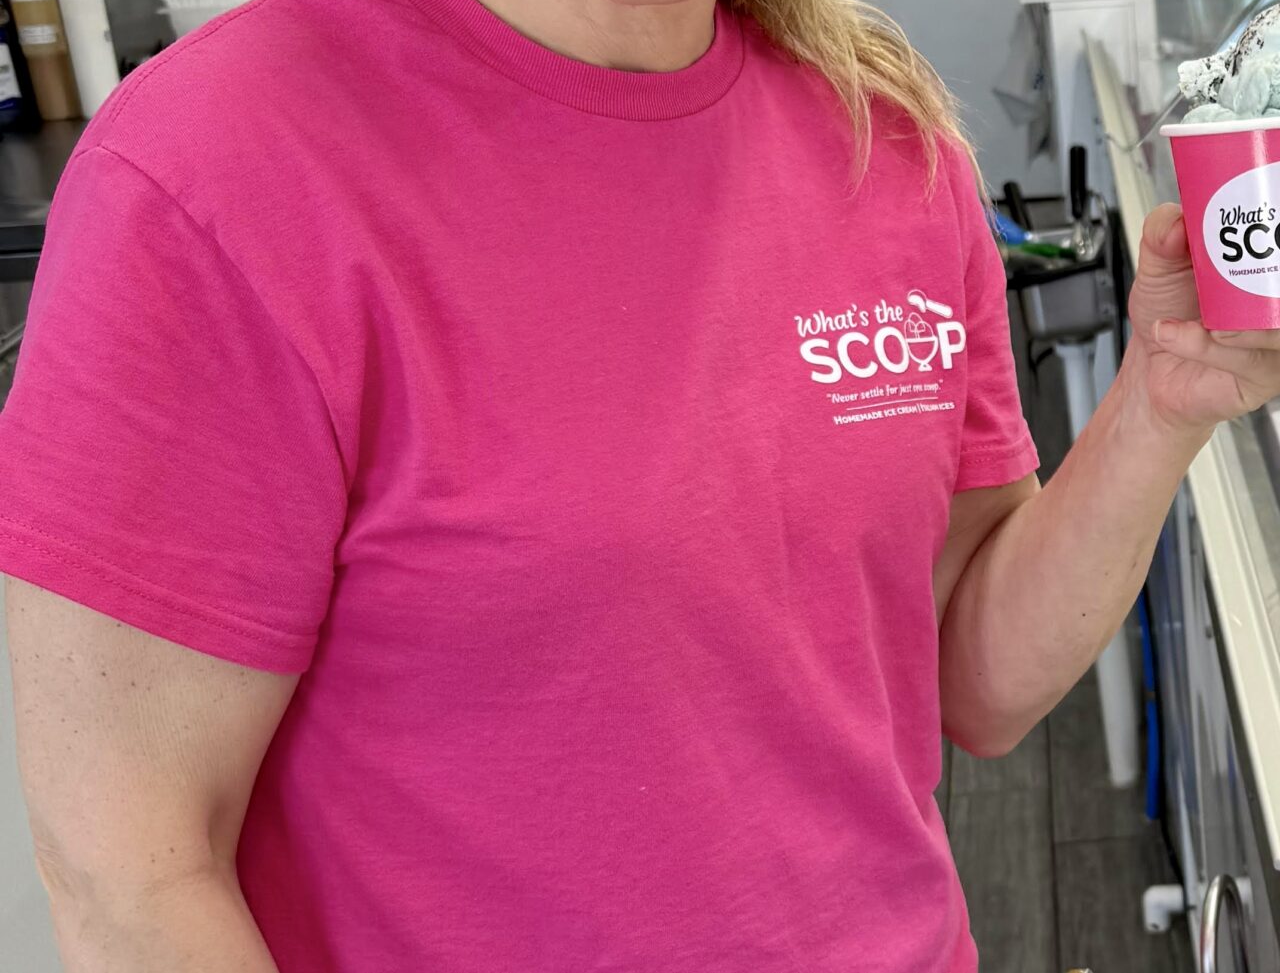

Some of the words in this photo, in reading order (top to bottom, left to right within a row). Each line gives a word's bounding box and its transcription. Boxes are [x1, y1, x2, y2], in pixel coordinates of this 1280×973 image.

[1220, 202, 1276, 226] What's
[1228, 266, 1266, 276] HOMEMADE
[1267, 265, 1278, 273] ICE
[794, 304, 870, 337] What's
[874, 299, 904, 324] the
[860, 386, 884, 400] settle
[886, 384, 898, 397] for
[898, 383, 912, 396] just
[833, 411, 884, 425] HOMEMADE
[883, 408, 896, 417] ICE
[897, 405, 918, 416] CREAM
[938, 401, 955, 411] ICES
